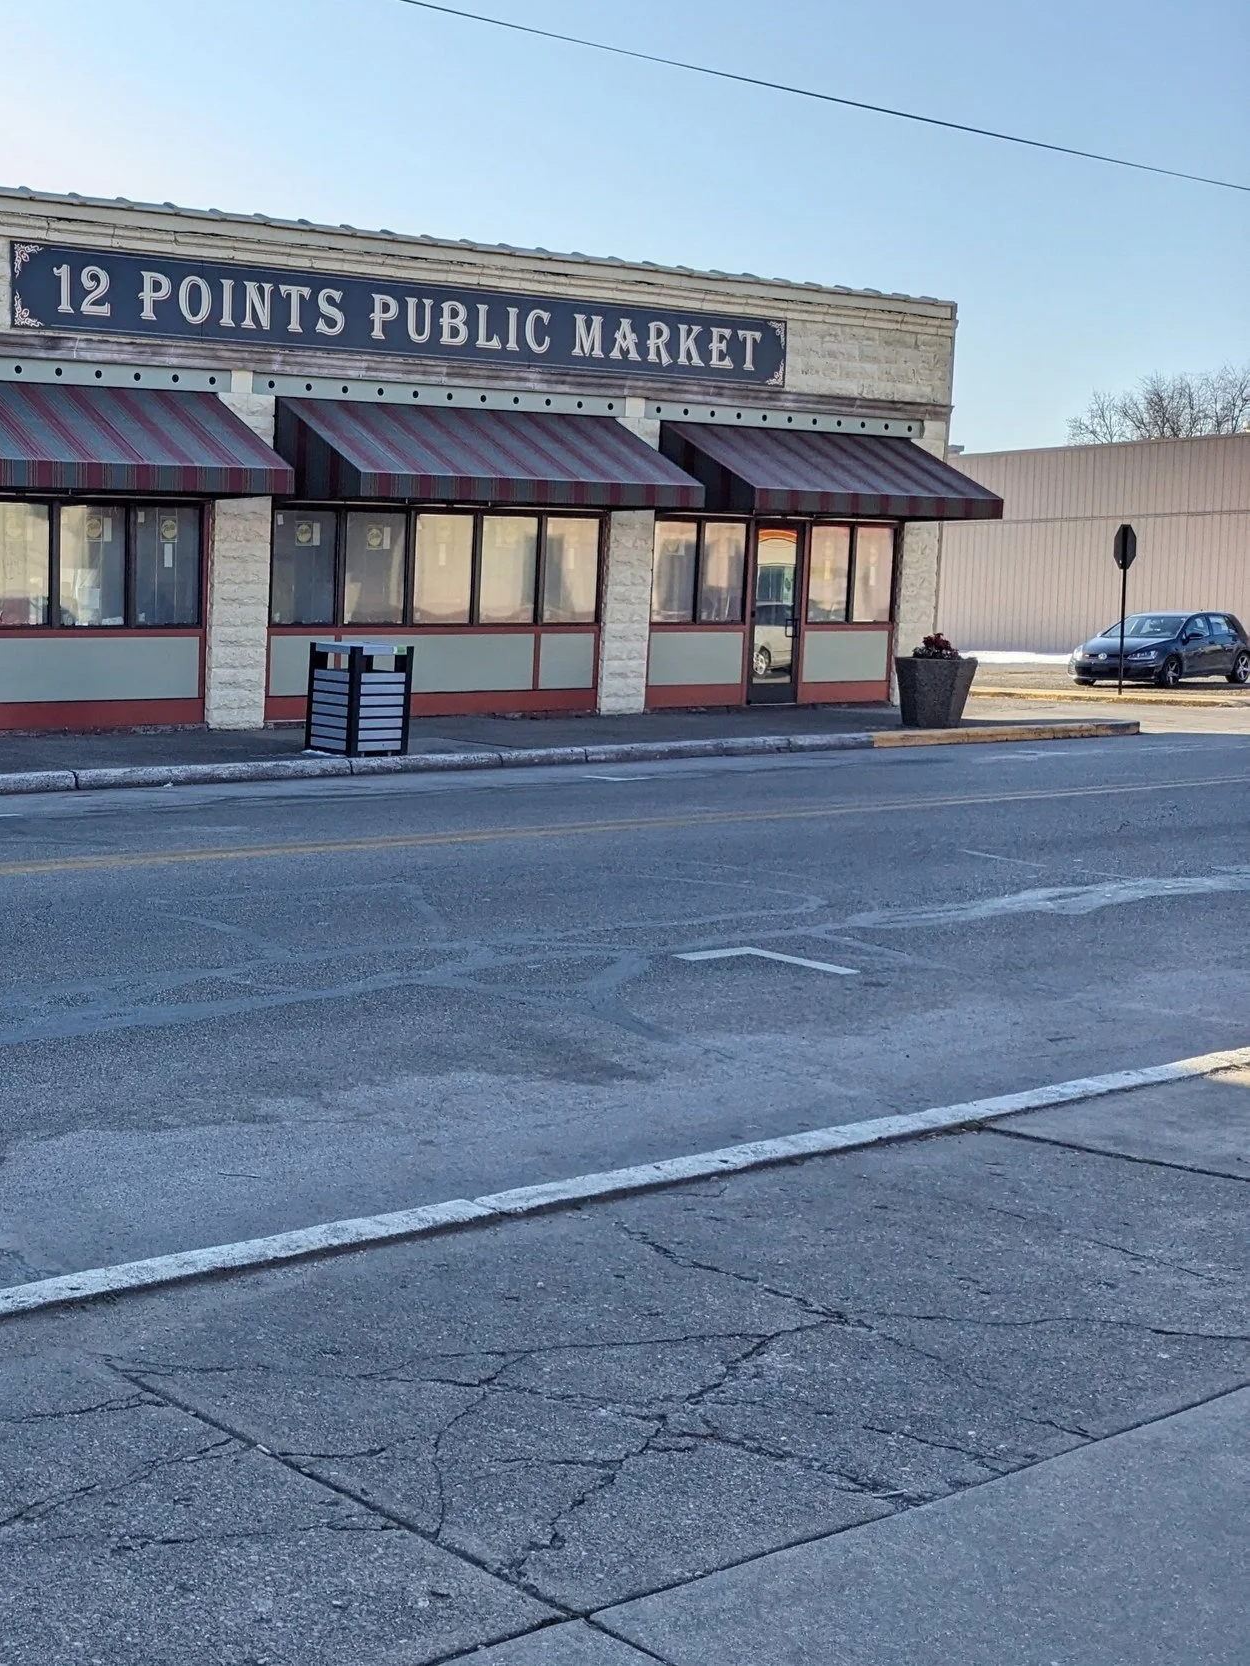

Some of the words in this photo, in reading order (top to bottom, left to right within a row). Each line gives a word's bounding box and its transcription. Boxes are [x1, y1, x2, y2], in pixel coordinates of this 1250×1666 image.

[52, 263, 111, 317] 12
[138, 271, 345, 336] POINTS
[368, 293, 551, 355] PUBLIC
[570, 312, 762, 371] MARKET
